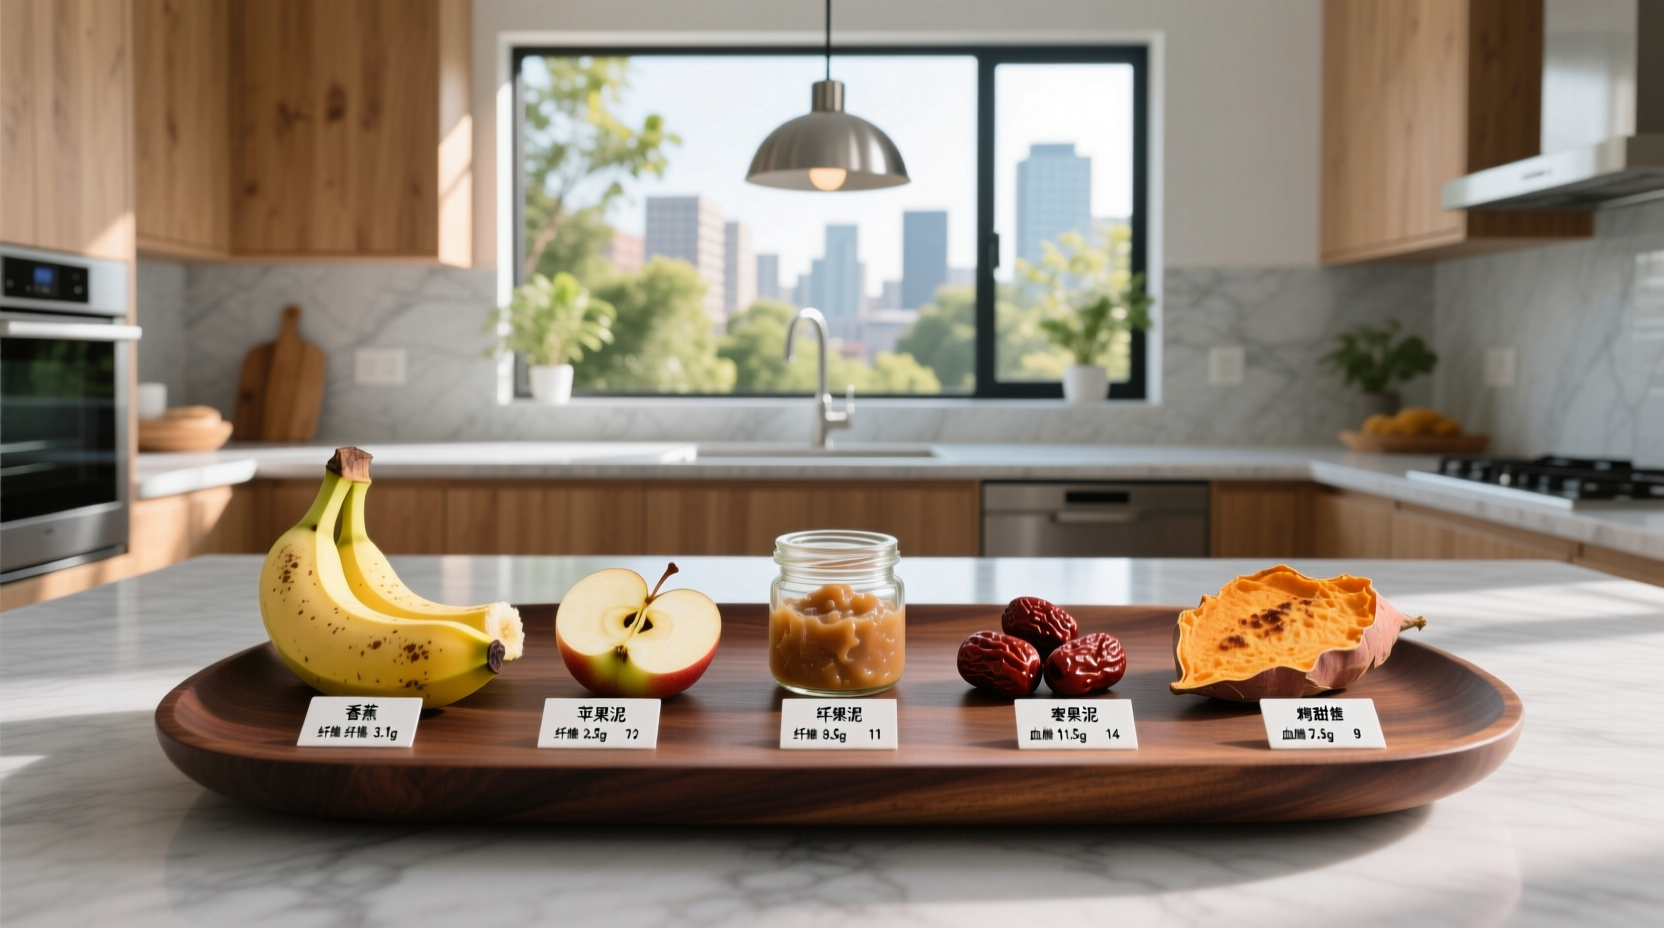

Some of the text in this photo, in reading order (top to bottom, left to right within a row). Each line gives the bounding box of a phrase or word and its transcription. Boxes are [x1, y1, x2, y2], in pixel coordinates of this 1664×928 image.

[346, 703, 379, 721] 香蕉
[577, 705, 626, 722] 苹果泥
[373, 726, 398, 741] 3.1g
[869, 728, 881, 740] 11
[1057, 728, 1087, 743] 11.5g
[1106, 728, 1120, 740] 14
[1308, 728, 1334, 742] 7.5g
[1353, 728, 1361, 739] 9
